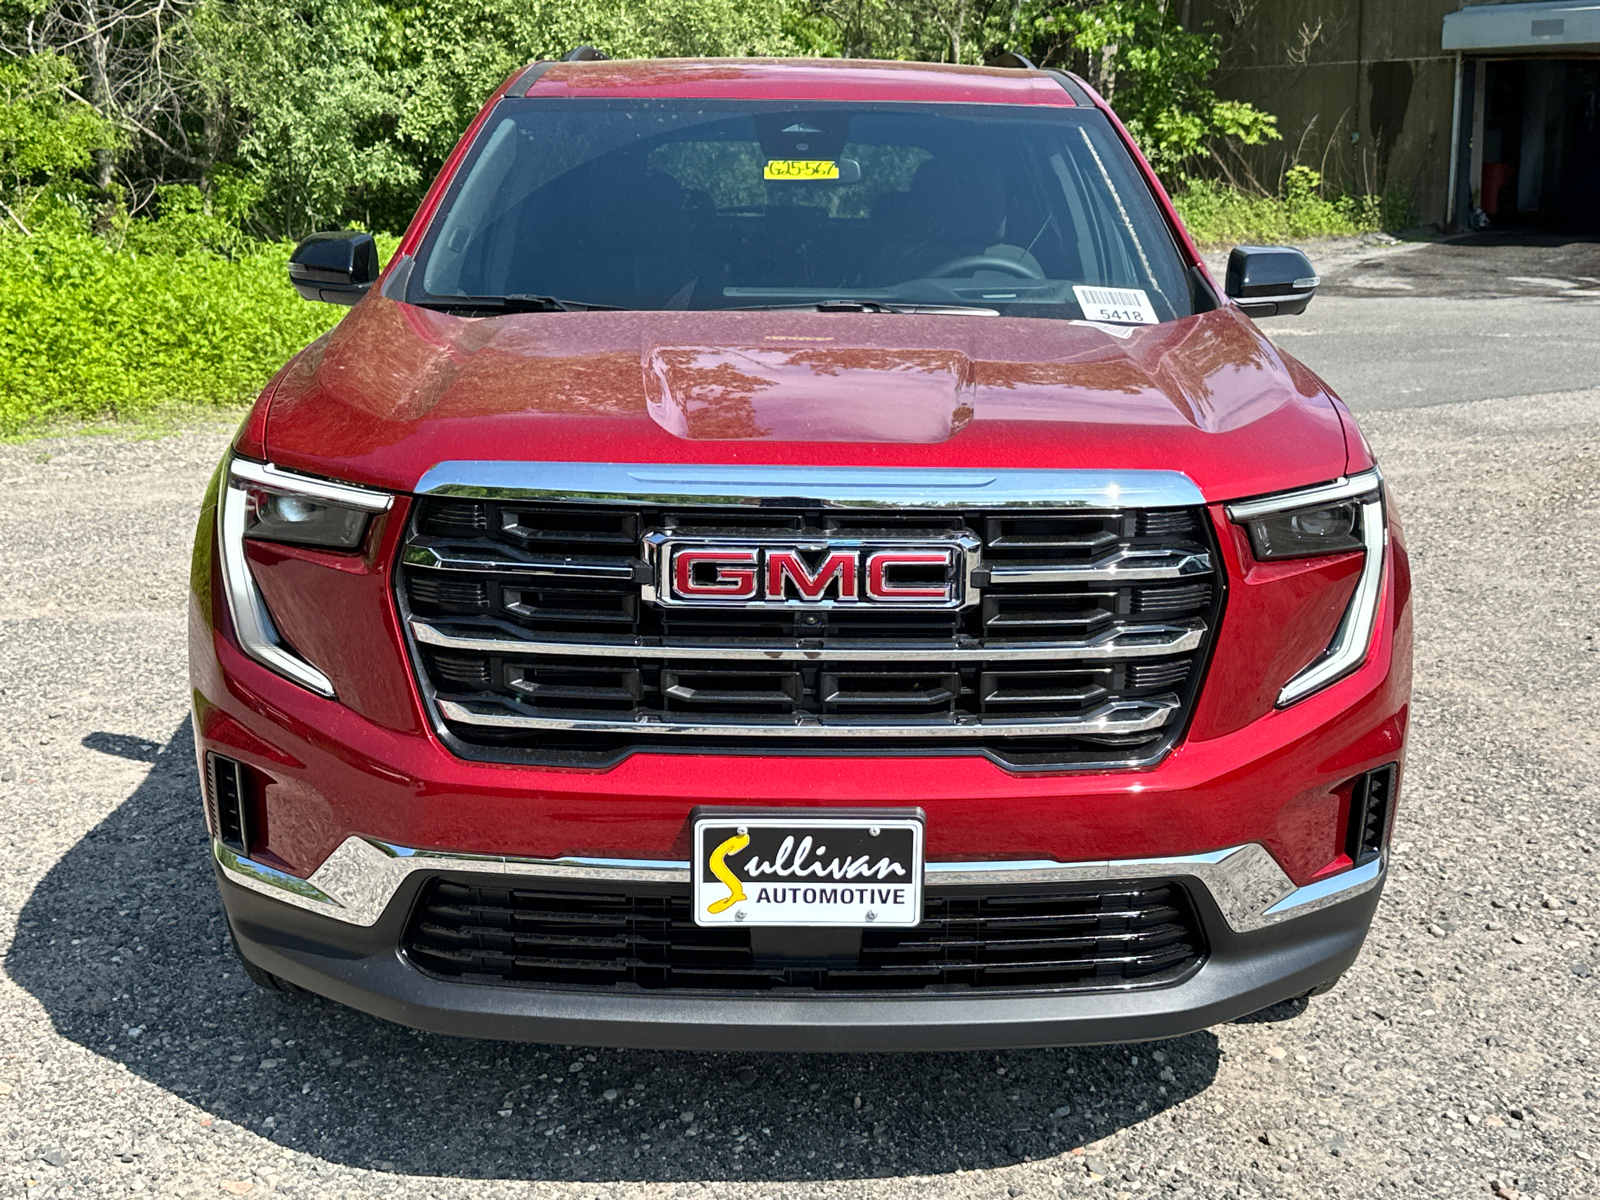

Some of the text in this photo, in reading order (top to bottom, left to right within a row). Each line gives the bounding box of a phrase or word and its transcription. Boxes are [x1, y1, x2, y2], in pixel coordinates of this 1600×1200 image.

[1100, 309, 1144, 322] 5418
[673, 550, 951, 600] GMC
[707, 833, 906, 914] Sullivan
[756, 887, 905, 905] AUTOMOTIVE
